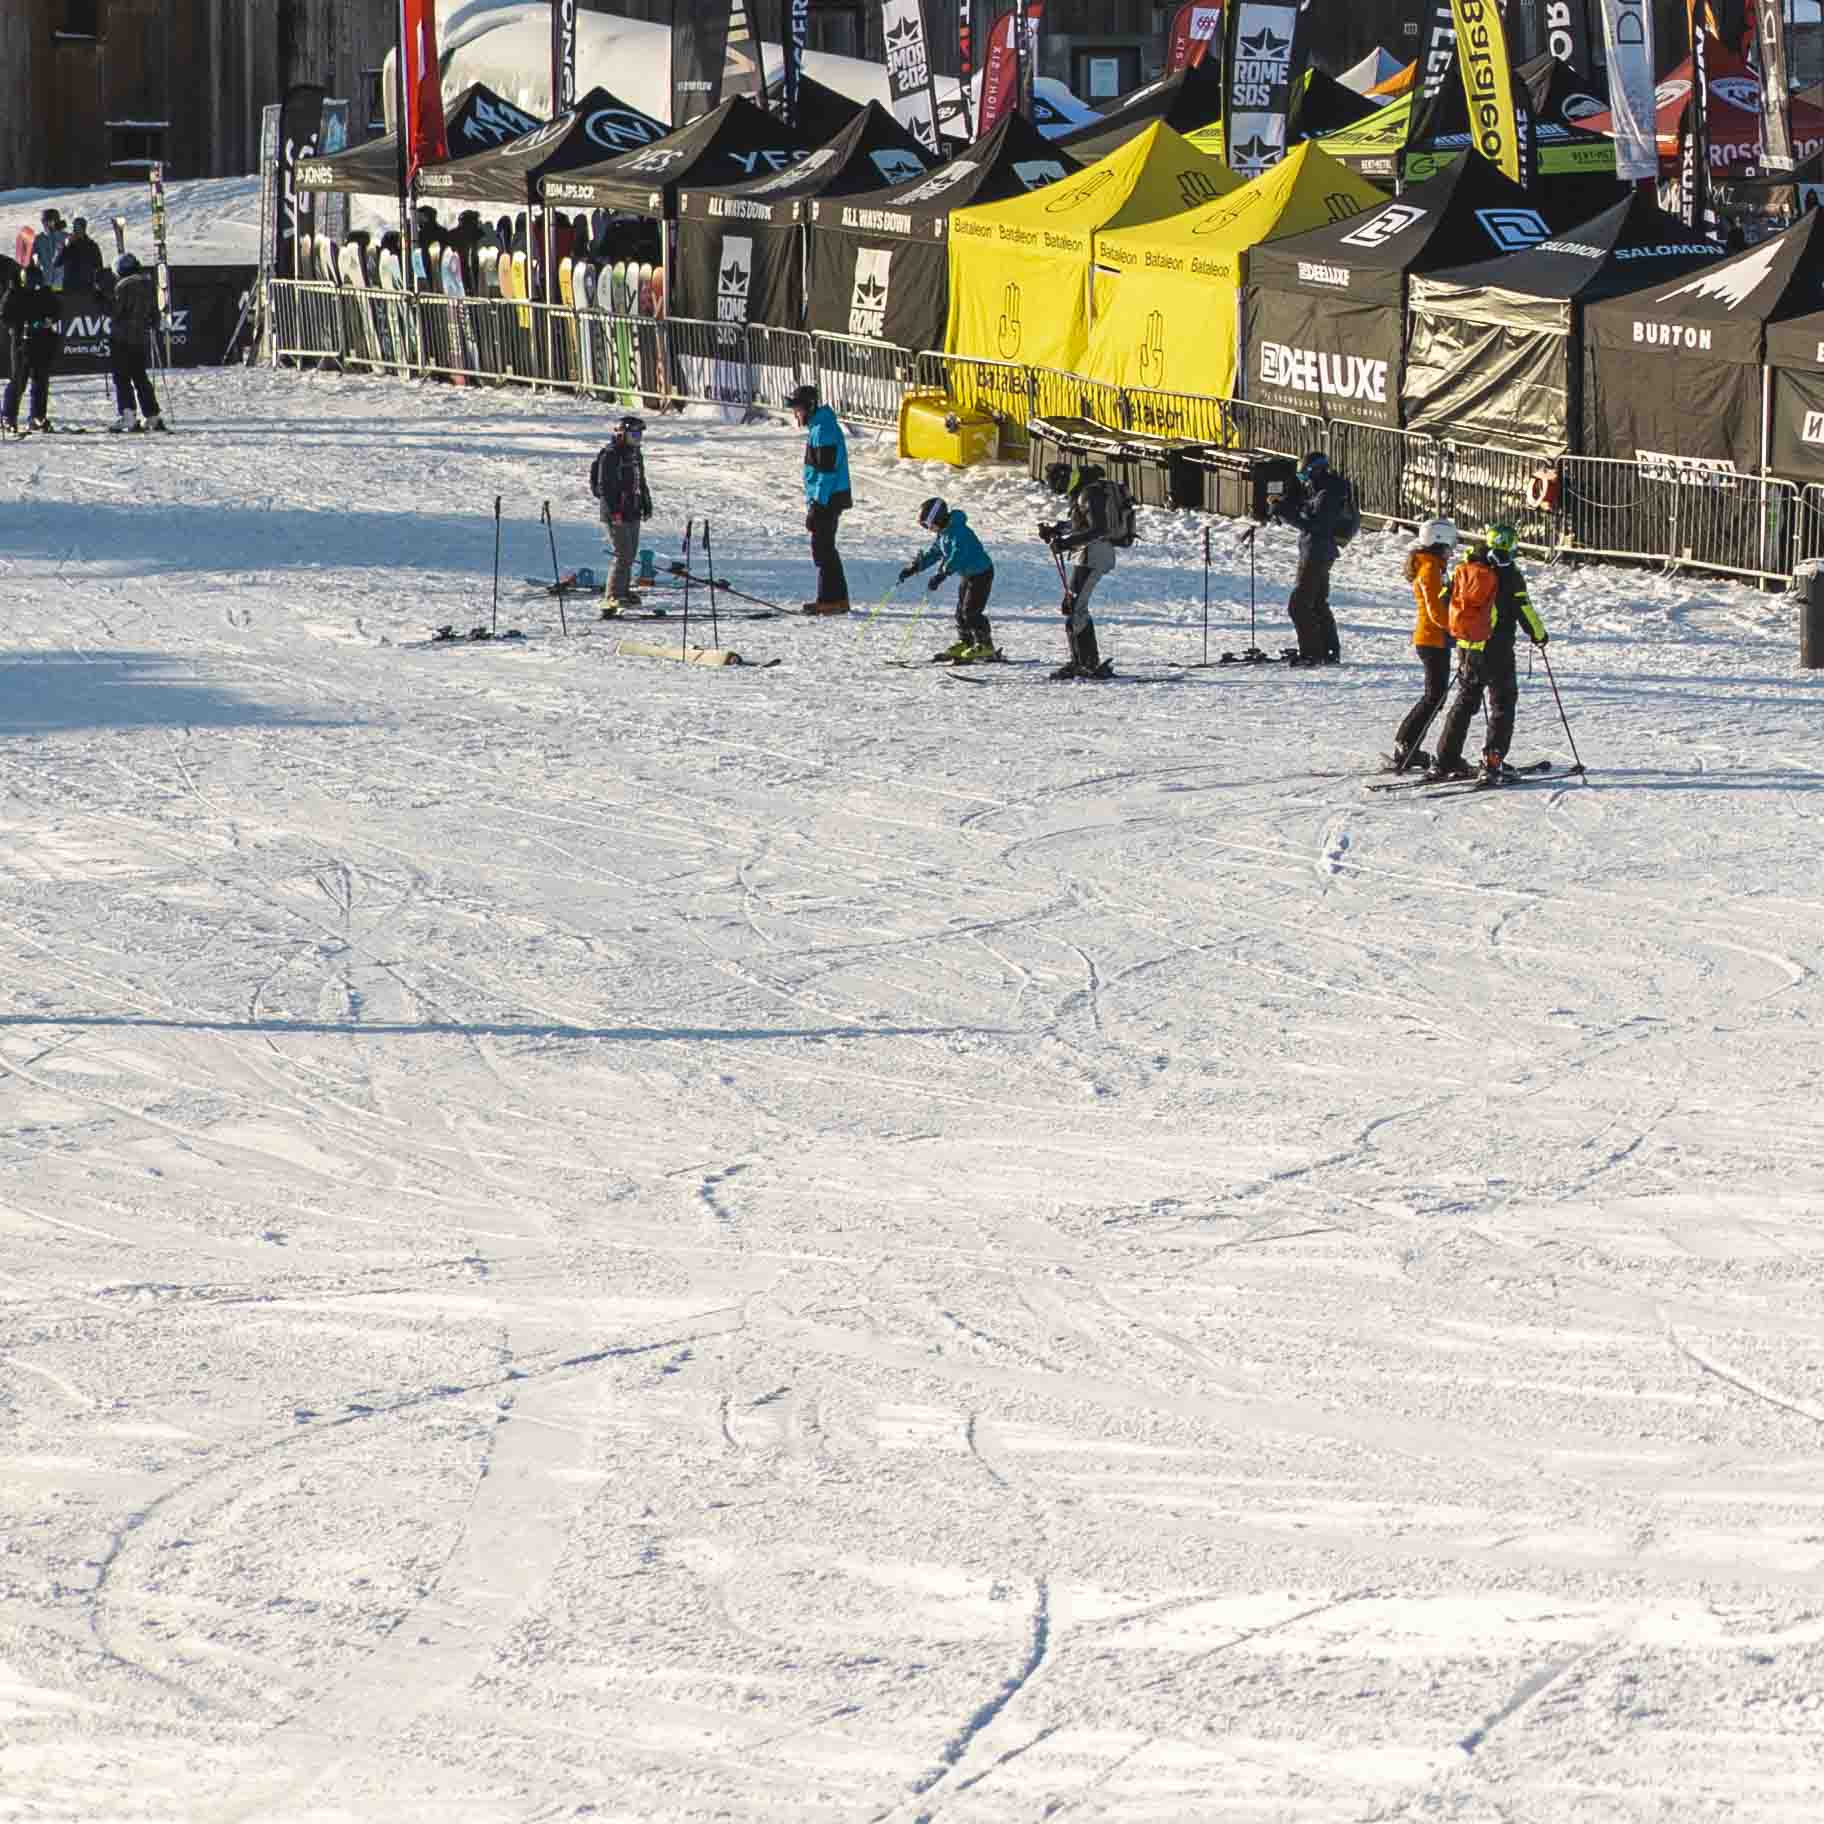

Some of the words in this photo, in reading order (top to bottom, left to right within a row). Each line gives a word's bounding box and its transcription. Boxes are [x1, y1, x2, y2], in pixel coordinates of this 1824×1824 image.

[1233, 59, 1289, 85] ROME
[1232, 83, 1271, 107] SDS
[708, 197, 724, 217] ALL
[842, 207, 858, 227] ALL
[954, 218, 993, 240] Bataleon
[999, 224, 1040, 246] Bataleon
[1044, 230, 1085, 253] Bataleon
[1100, 242, 1138, 266] Bataleon
[1145, 251, 1184, 273] Bataleon
[1536, 241, 1606, 259] SALOMON
[1615, 242, 1728, 260] SALOMON
[717, 296, 748, 323] ROME
[850, 308, 886, 338] ROME
[1632, 320, 1713, 351] BURTON
[1279, 345, 1388, 403] DEELUXE
